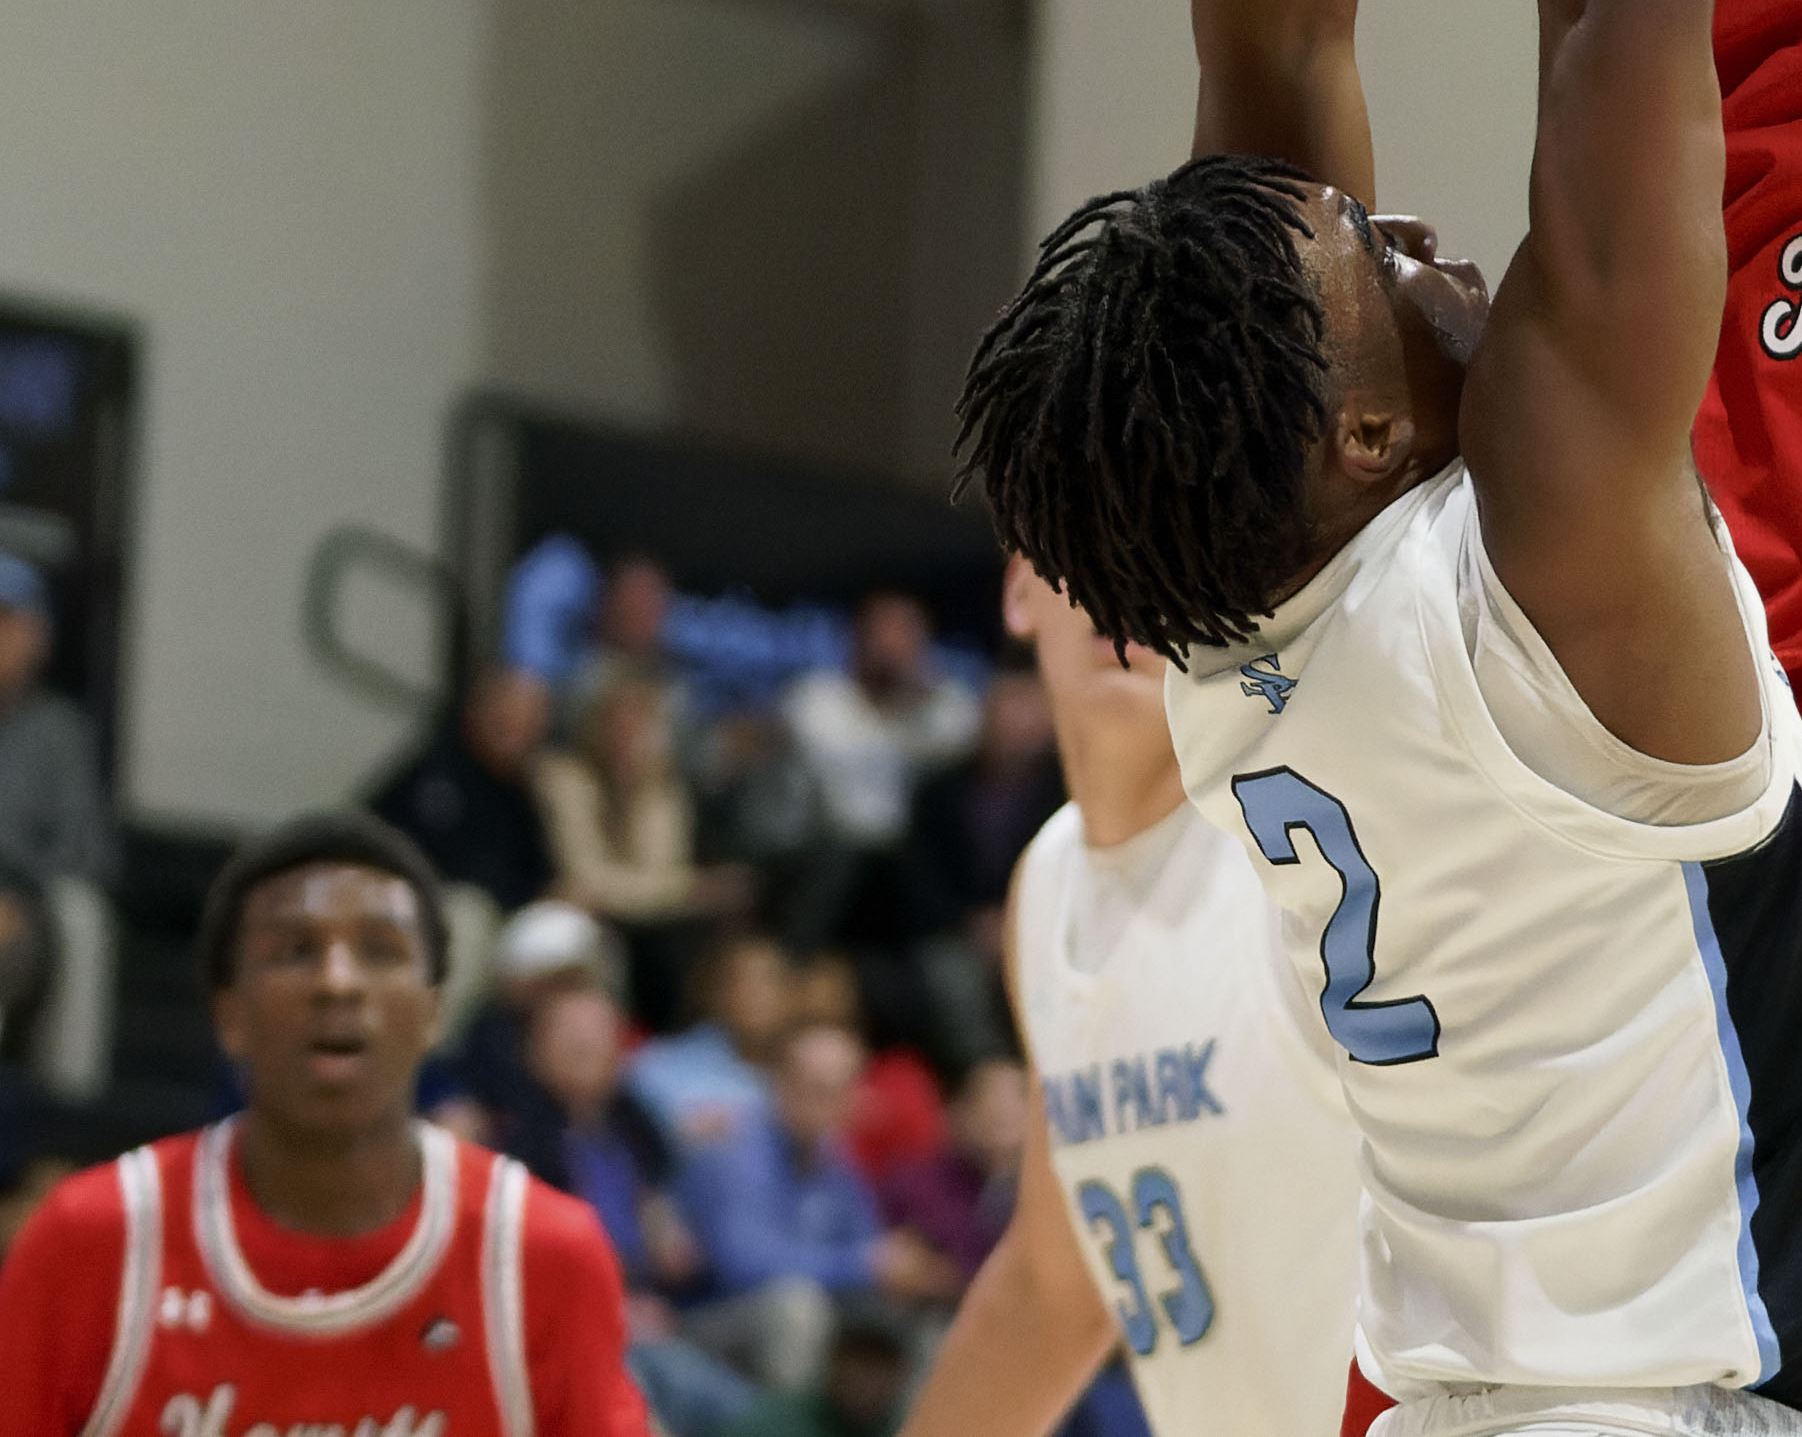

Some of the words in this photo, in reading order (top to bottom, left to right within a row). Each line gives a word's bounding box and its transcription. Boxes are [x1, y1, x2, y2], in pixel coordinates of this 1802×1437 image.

[1231, 764, 1440, 1066] 2
[1110, 1036, 1227, 1136] PARK
[1077, 1164, 1216, 1357] 33
